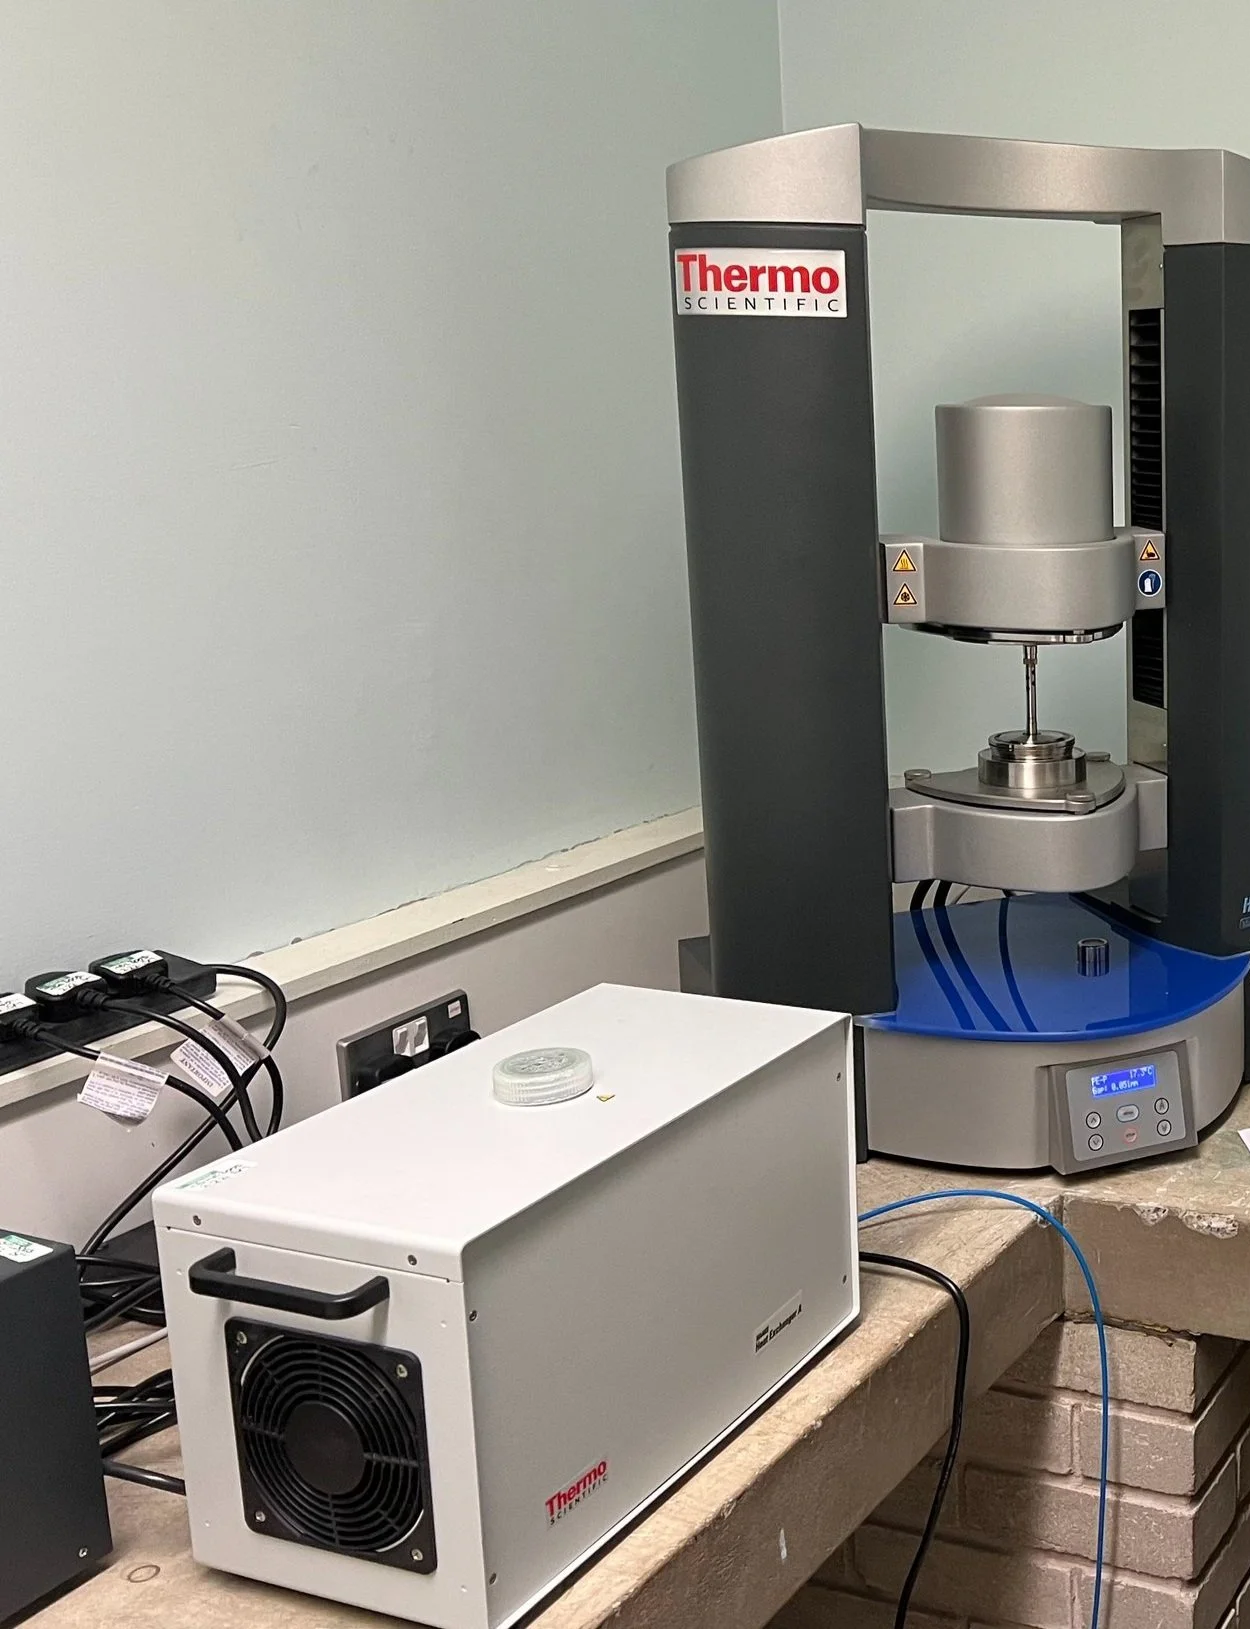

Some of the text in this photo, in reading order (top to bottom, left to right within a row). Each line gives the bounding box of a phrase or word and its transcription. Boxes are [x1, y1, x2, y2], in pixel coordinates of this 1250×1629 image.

[677, 254, 840, 294] Thermo
[684, 297, 839, 312] SCIENTIFIC
[545, 1461, 607, 1517] Thermo
[550, 1474, 608, 1525] SCIENTIFIC
